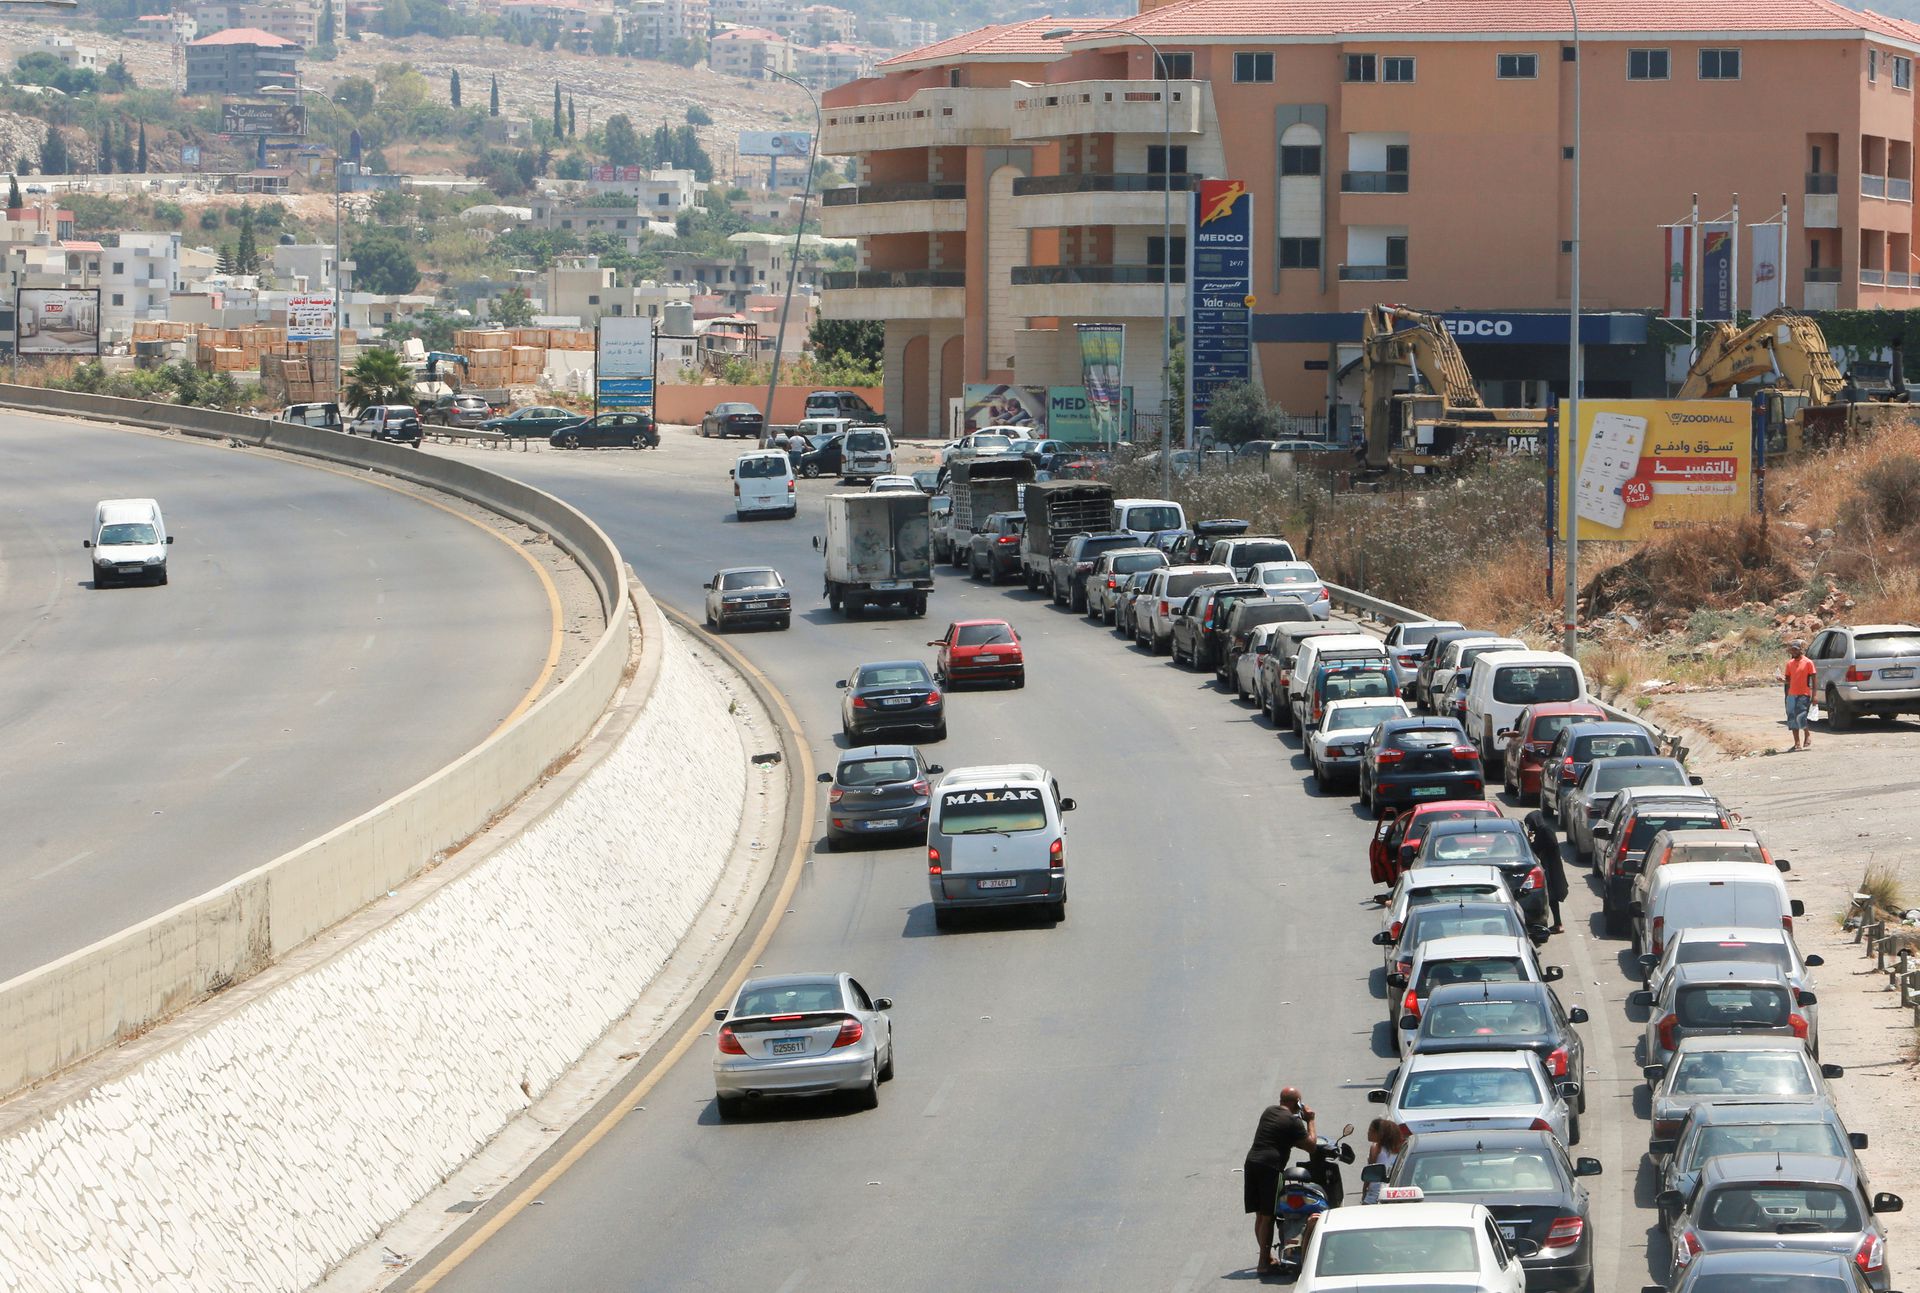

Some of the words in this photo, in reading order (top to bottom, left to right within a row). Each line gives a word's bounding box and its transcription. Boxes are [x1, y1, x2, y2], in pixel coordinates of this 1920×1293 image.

[1199, 233, 1244, 242] MEDCO
[1719, 258, 1727, 312] MEDCO
[1202, 297, 1224, 308] Yala
[1445, 319, 1513, 336] EDCO
[1682, 414, 1735, 424] ZOODMALL
[1415, 446, 1428, 456] CAT
[1507, 436, 1538, 456] CAT
[1654, 460, 1734, 478] بالتقسيط
[946, 789, 1039, 806] MALAK
[773, 1042, 805, 1054] G255611
[1387, 1189, 1416, 1198] TAXI
